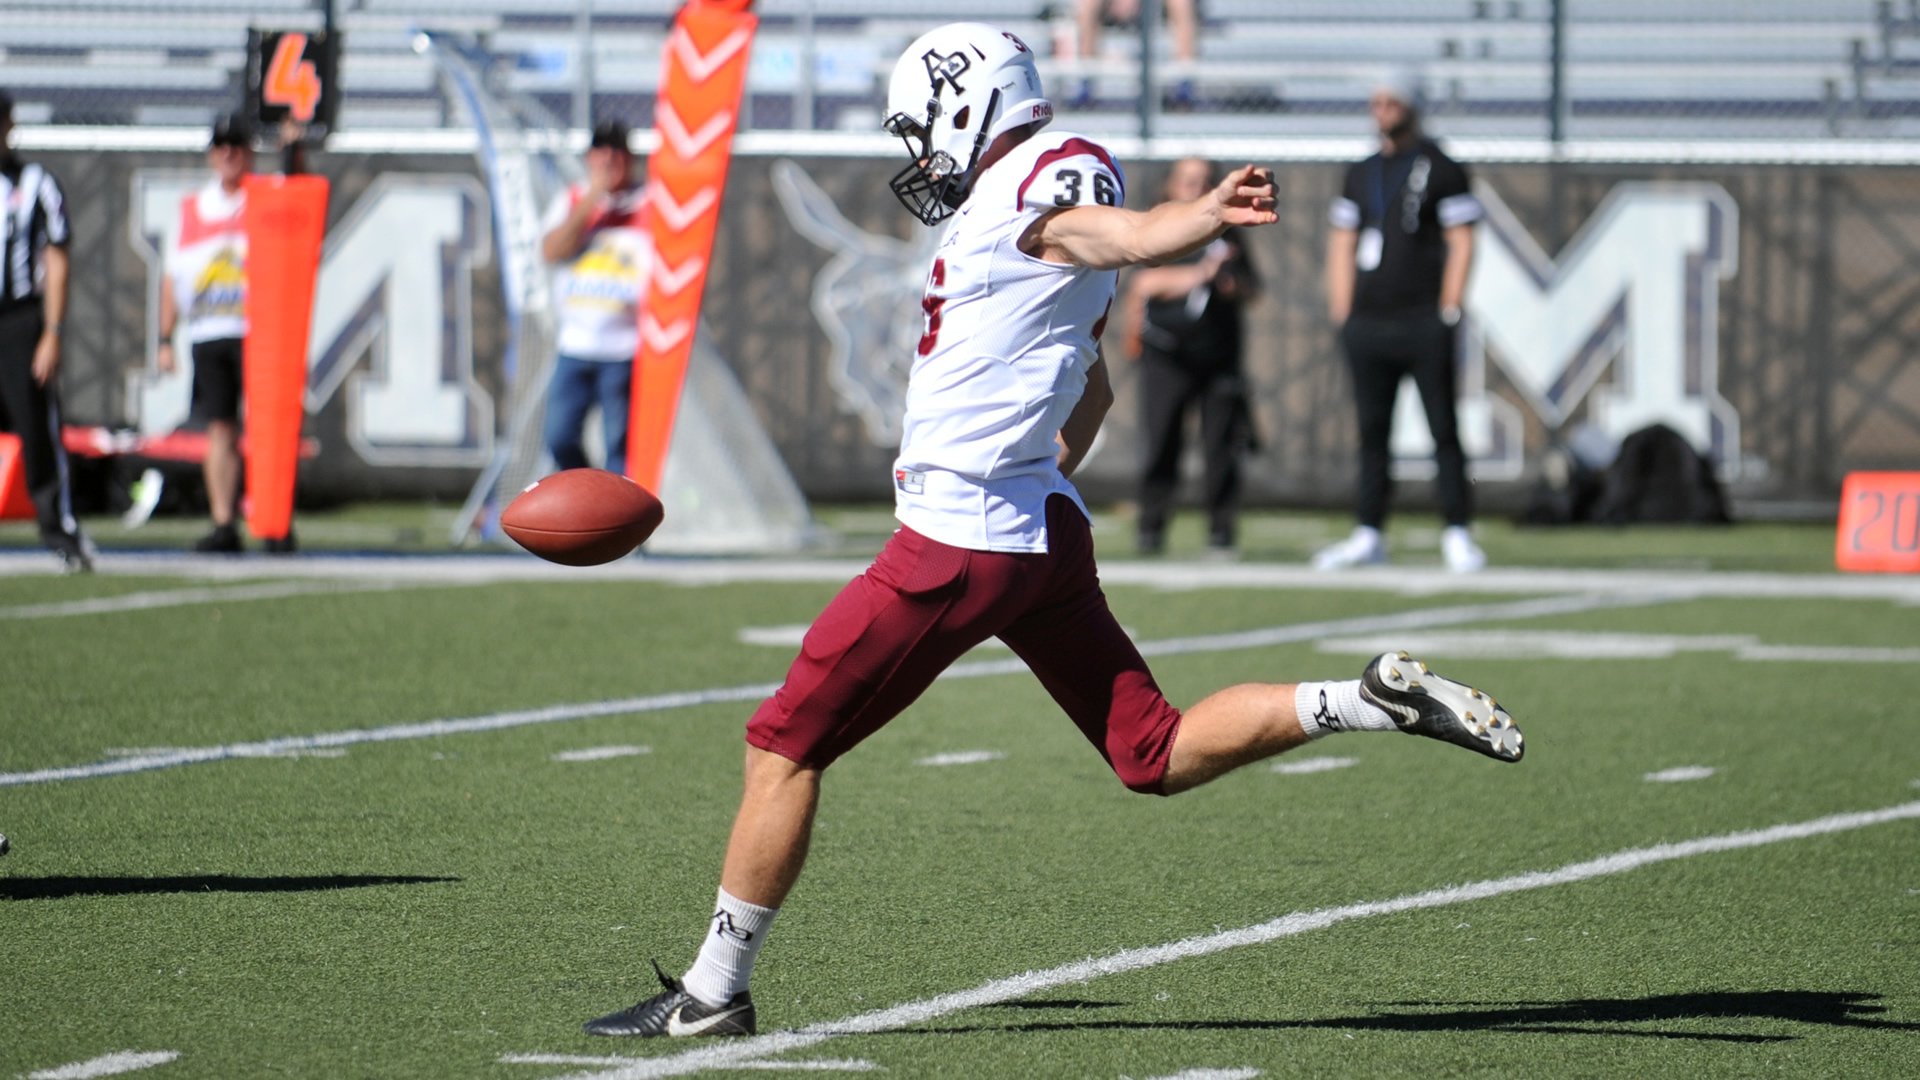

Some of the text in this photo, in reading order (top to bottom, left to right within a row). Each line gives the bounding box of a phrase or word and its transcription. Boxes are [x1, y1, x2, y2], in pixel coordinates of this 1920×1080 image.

[264, 33, 322, 122] 4
[1054, 169, 1116, 207] 36
[1852, 491, 1920, 553] 20
